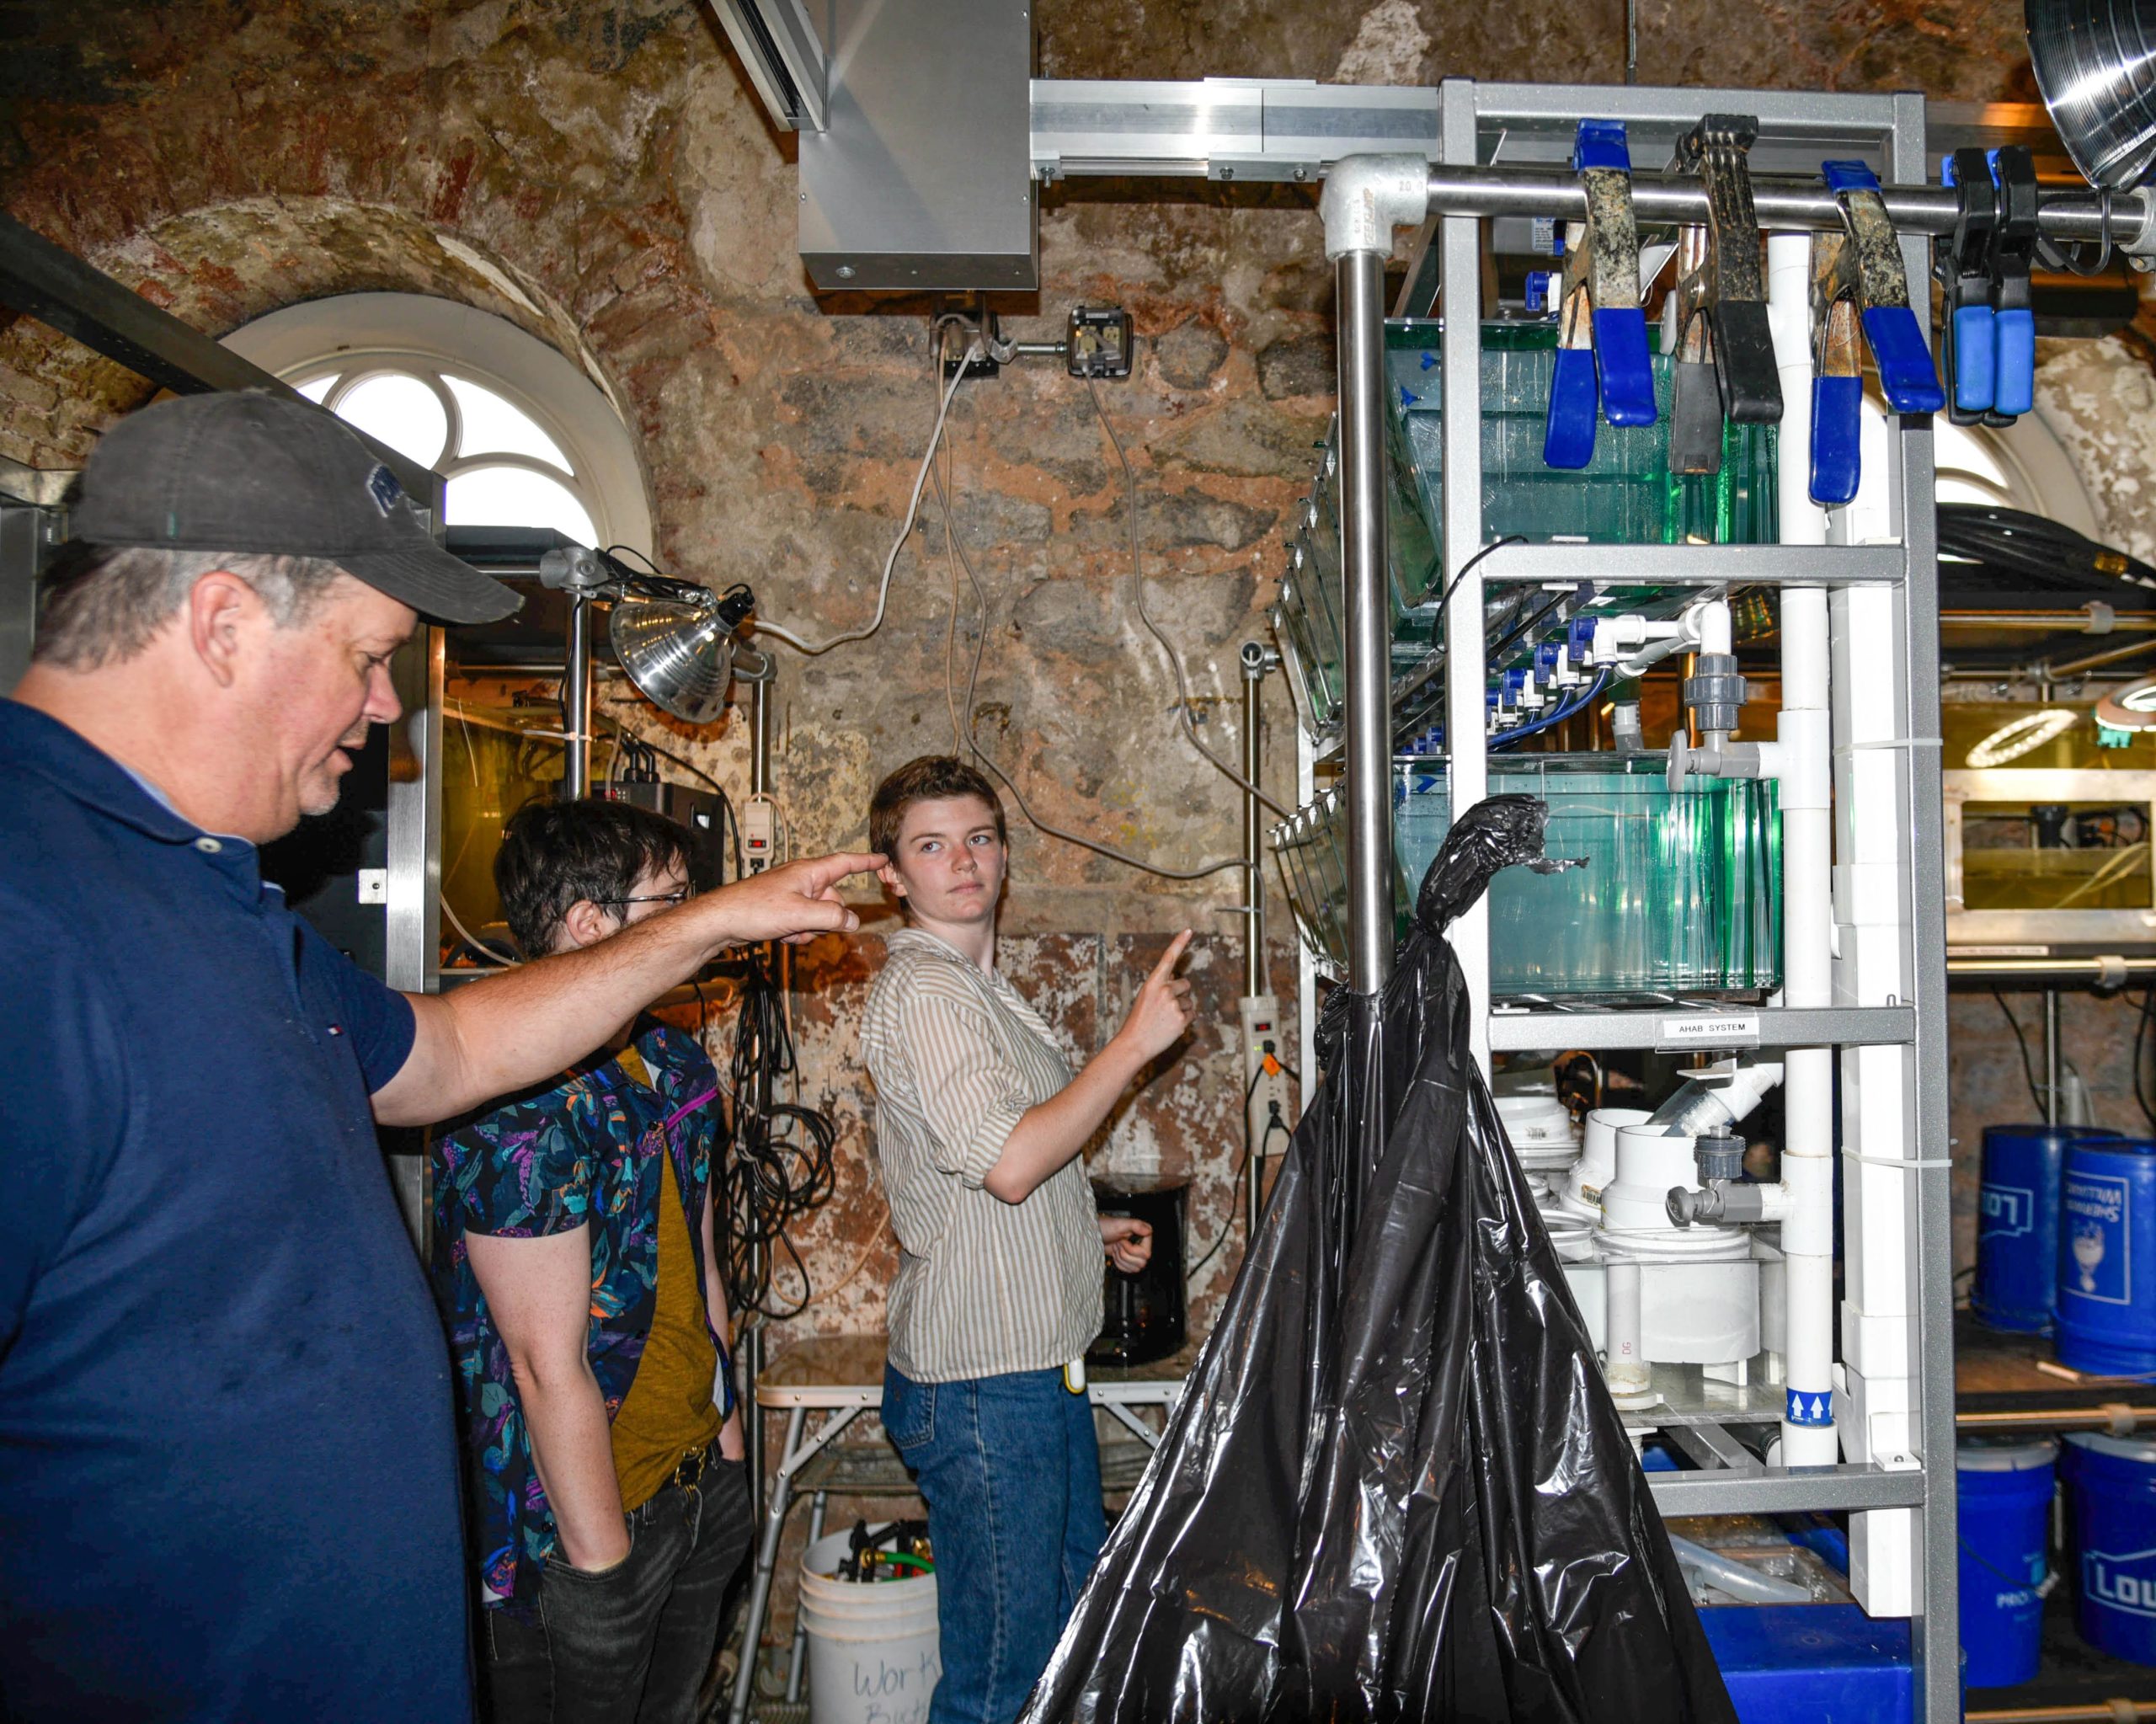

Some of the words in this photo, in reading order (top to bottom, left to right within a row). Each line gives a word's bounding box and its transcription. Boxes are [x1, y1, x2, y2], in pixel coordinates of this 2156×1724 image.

[1709, 1023, 1746, 1032] SYSTEM
[1982, 1192, 2018, 1225] LO
[1621, 1341, 1631, 1355] DG
[854, 1649, 942, 1698] Work
